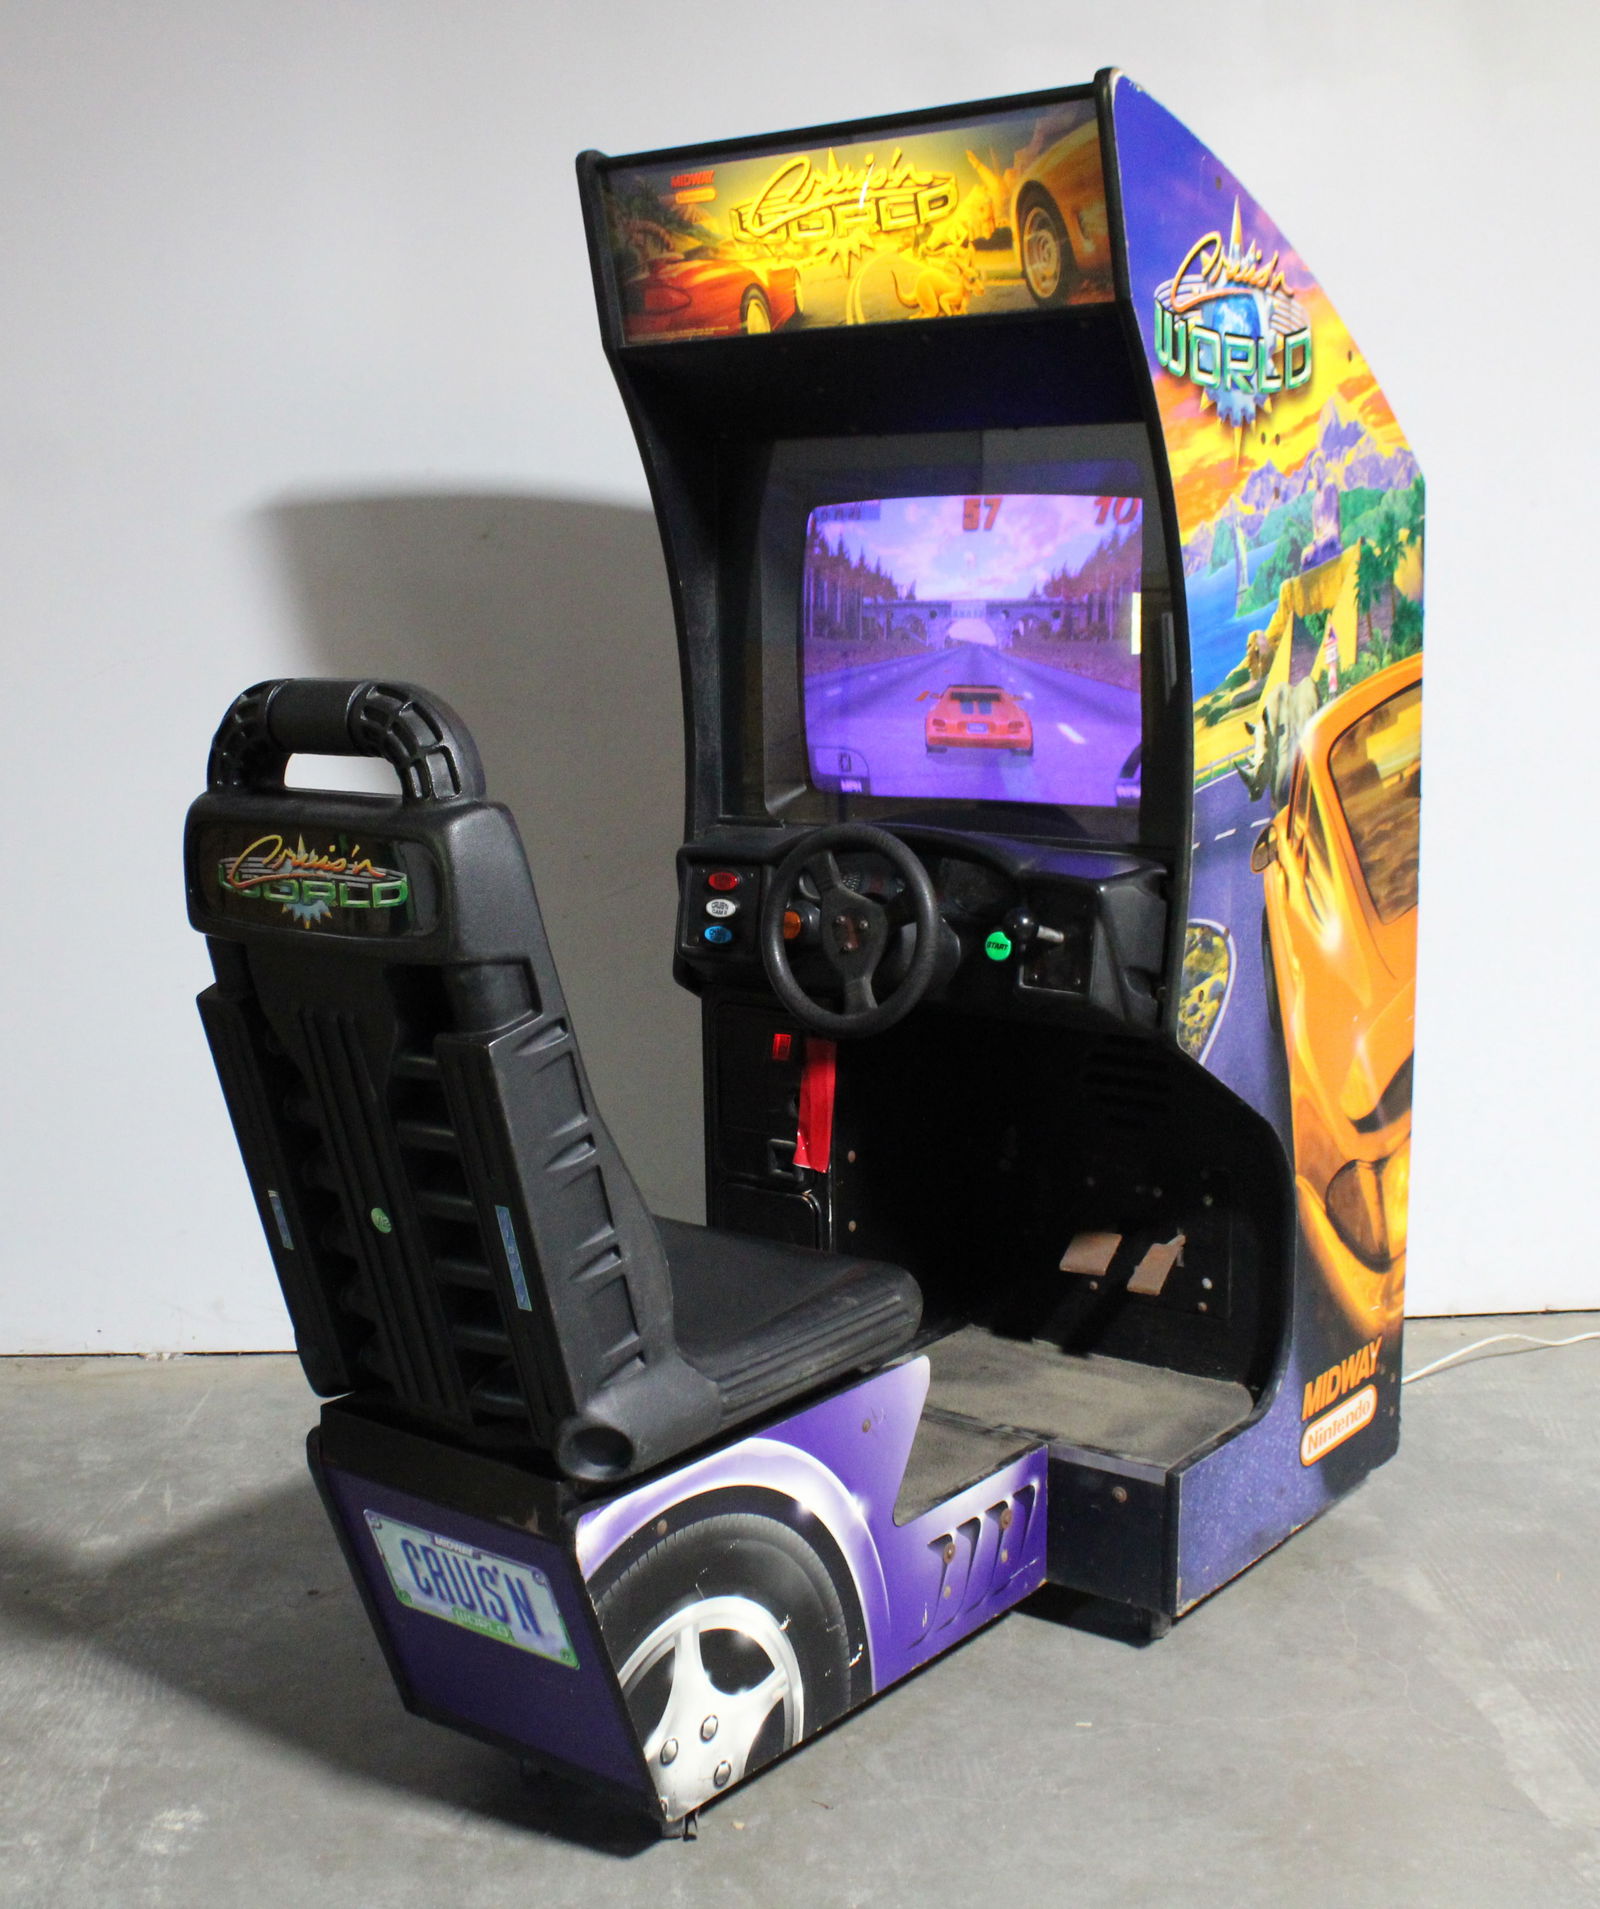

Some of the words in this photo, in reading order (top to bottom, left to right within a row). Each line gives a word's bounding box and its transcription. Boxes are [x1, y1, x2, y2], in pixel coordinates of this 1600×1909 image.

[1154, 298, 1312, 393] WORLD
[986, 941, 1008, 951] START
[1301, 1335, 1383, 1422] MIDWAY
[1306, 1398, 1371, 1455] Nintendo
[400, 1538, 544, 1637] CRUIS'N
